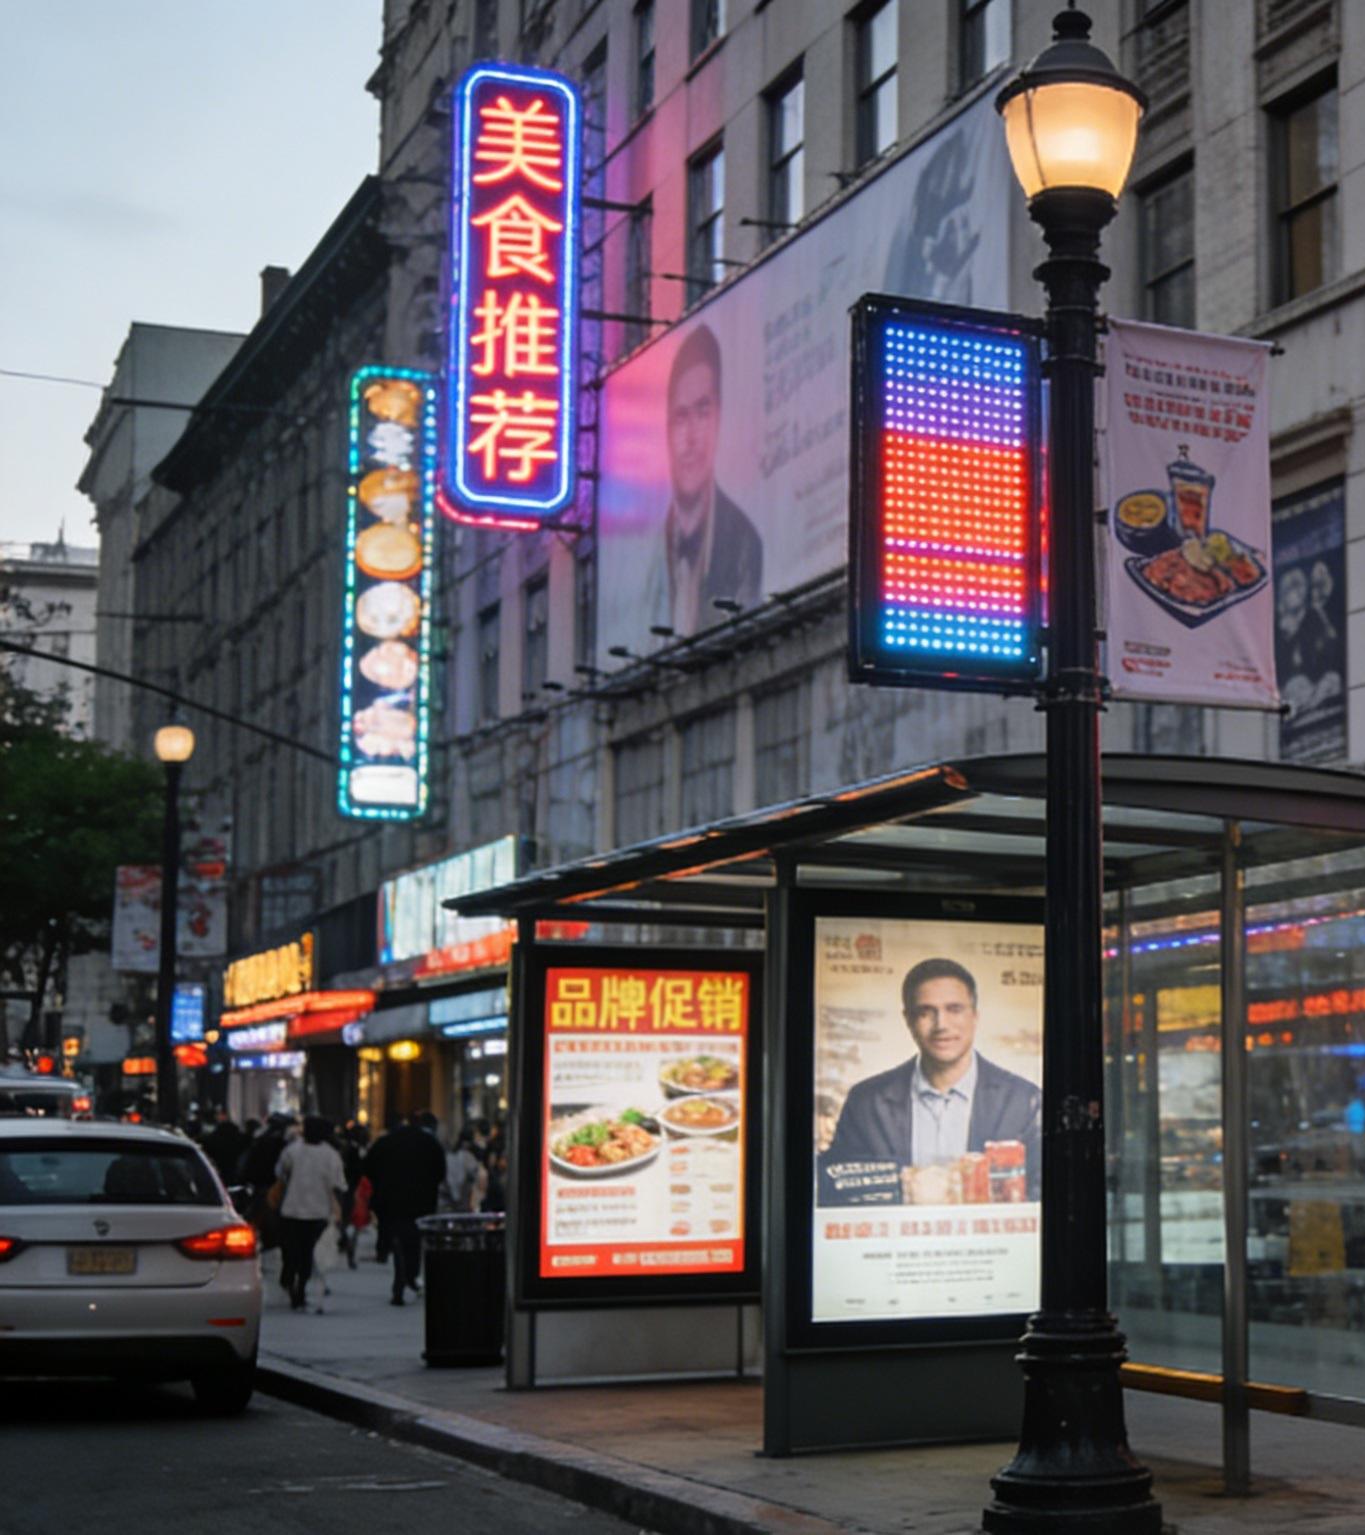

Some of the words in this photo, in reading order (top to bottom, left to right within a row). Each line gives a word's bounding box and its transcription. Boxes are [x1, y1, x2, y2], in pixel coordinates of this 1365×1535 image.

[469, 97, 562, 483] 美食推荐
[551, 977, 743, 1030] 品牌促销
